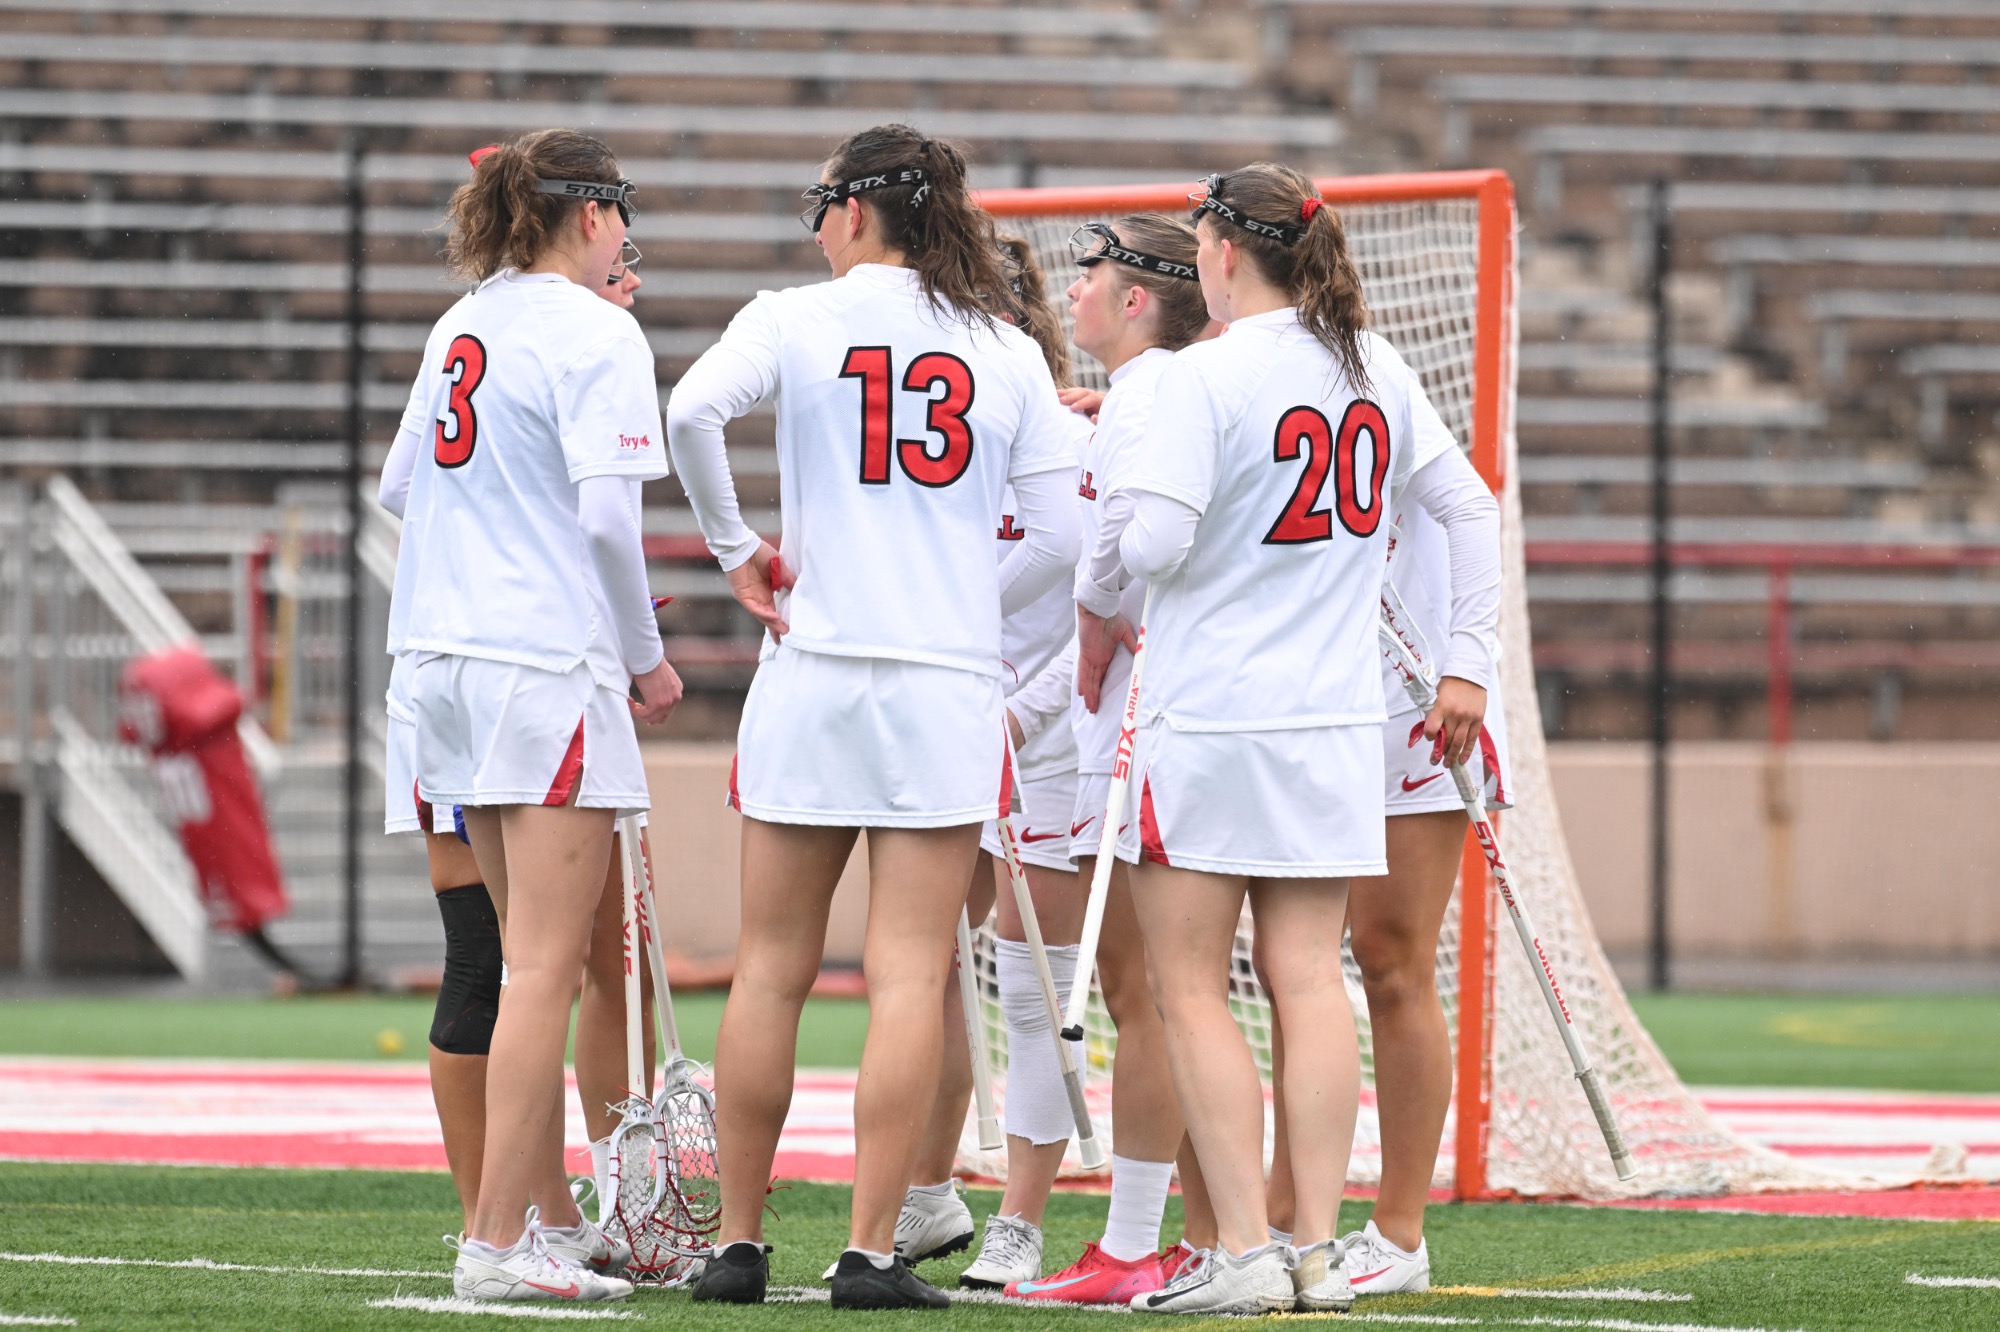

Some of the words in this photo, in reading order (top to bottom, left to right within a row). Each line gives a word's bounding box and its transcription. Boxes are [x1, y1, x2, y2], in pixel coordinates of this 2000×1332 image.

[564, 183, 604, 197] STX
[848, 174, 888, 193] STX
[1204, 196, 1236, 222] STX
[1244, 218, 1284, 239] STX
[1108, 245, 1146, 267] STX
[1155, 260, 1195, 278] STX
[434, 333, 487, 469] 3
[838, 345, 976, 489] 13
[618, 433, 639, 451] Ivy
[1260, 398, 1391, 545] 20
[1112, 724, 1137, 783] STX
[1126, 687, 1140, 721] ARIA
[1474, 821, 1506, 871] STX
[1497, 876, 1516, 908] ARIA
